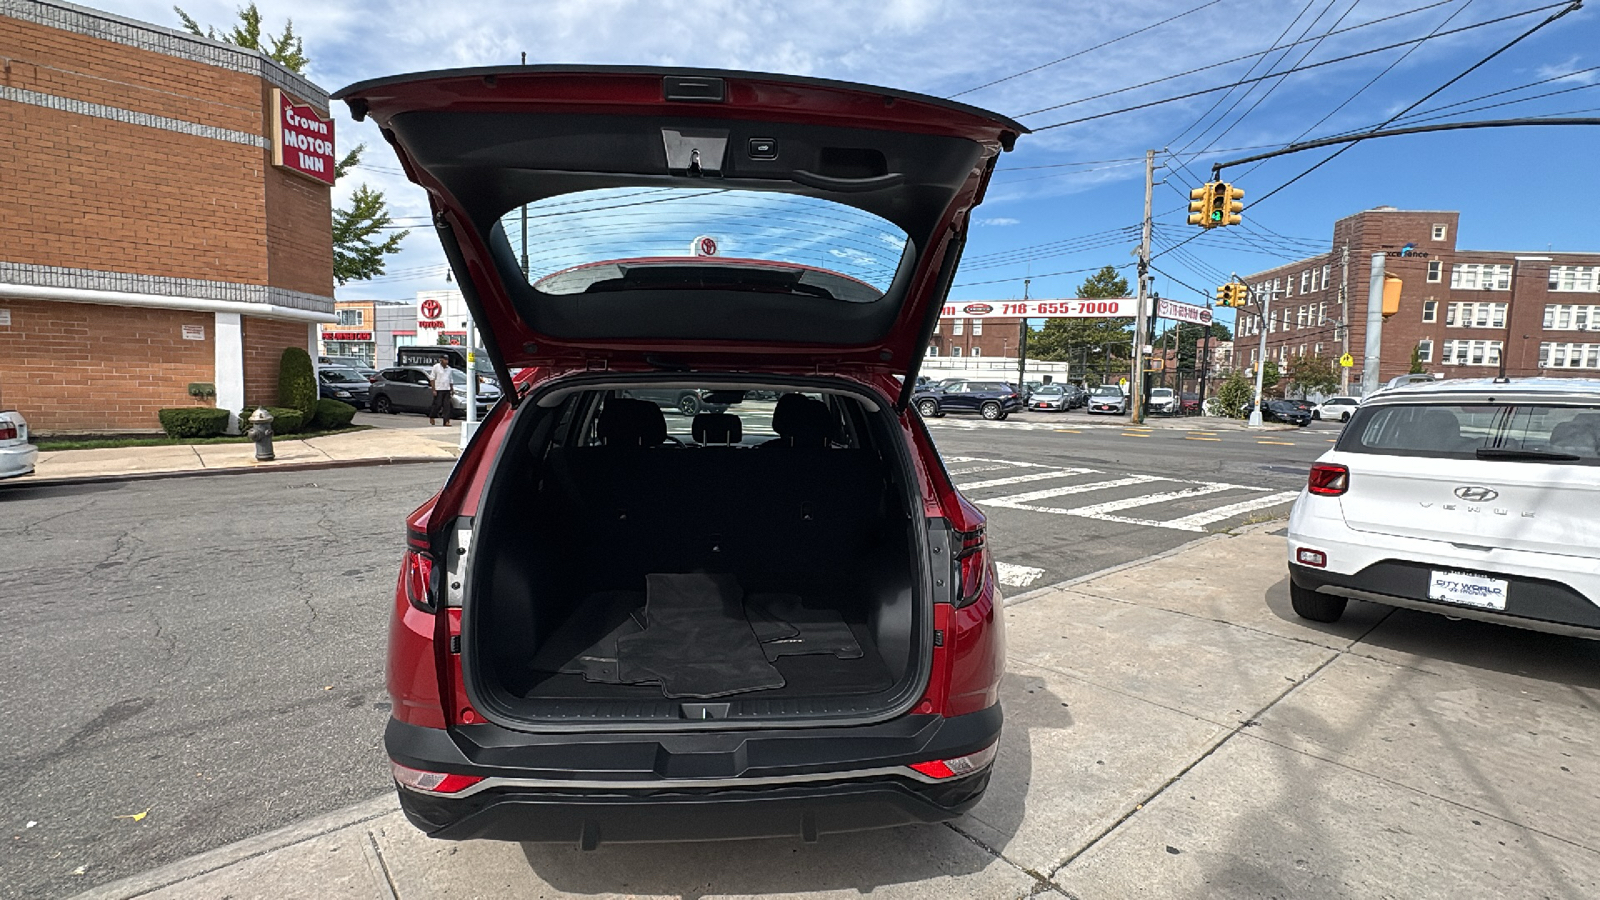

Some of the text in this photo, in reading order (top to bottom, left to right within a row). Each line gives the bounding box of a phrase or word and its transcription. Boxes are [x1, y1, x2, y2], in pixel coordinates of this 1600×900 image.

[286, 109, 328, 135] Crown
[284, 129, 334, 157] MOTOR
[298, 152, 324, 173] INN
[417, 321, 446, 329] TOYOTA
[1419, 502, 1536, 518] VENUE
[1436, 580, 1460, 588] CITY
[1461, 582, 1503, 594] WORLD
